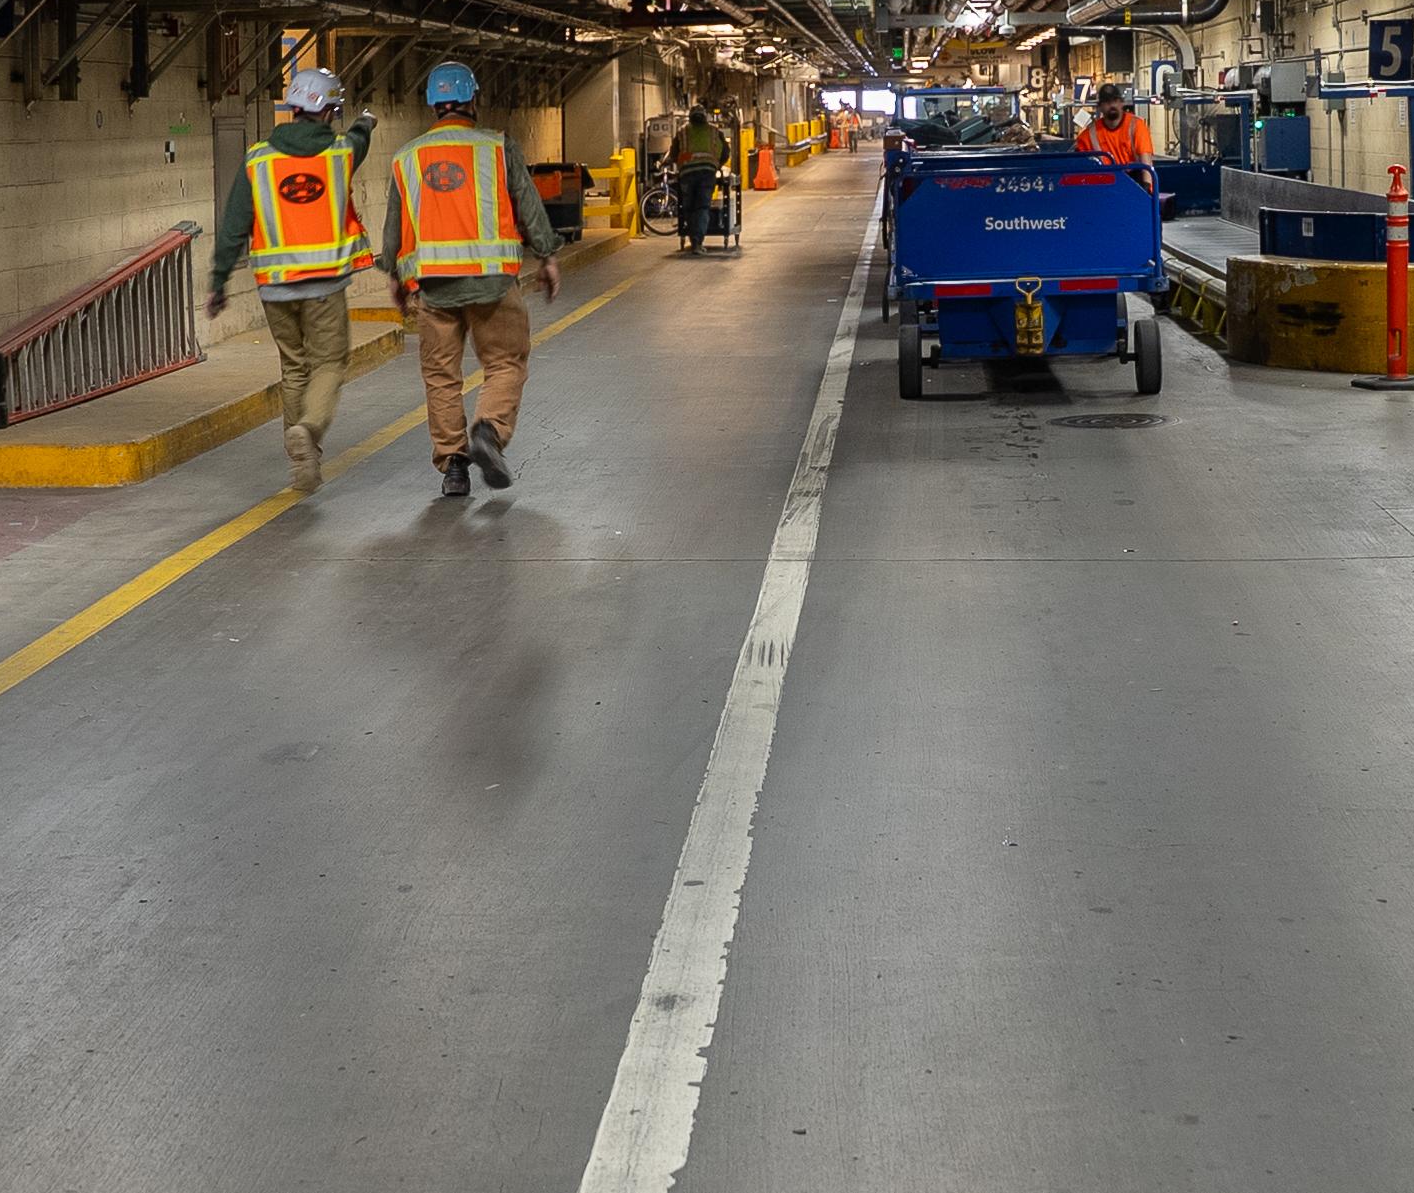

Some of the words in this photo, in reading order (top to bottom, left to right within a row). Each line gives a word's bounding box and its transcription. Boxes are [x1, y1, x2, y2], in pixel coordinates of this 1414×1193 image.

[1380, 26, 1402, 77] 5
[1031, 68, 1044, 88] 8
[1076, 78, 1091, 103] 7
[985, 216, 1066, 231] Southwest
